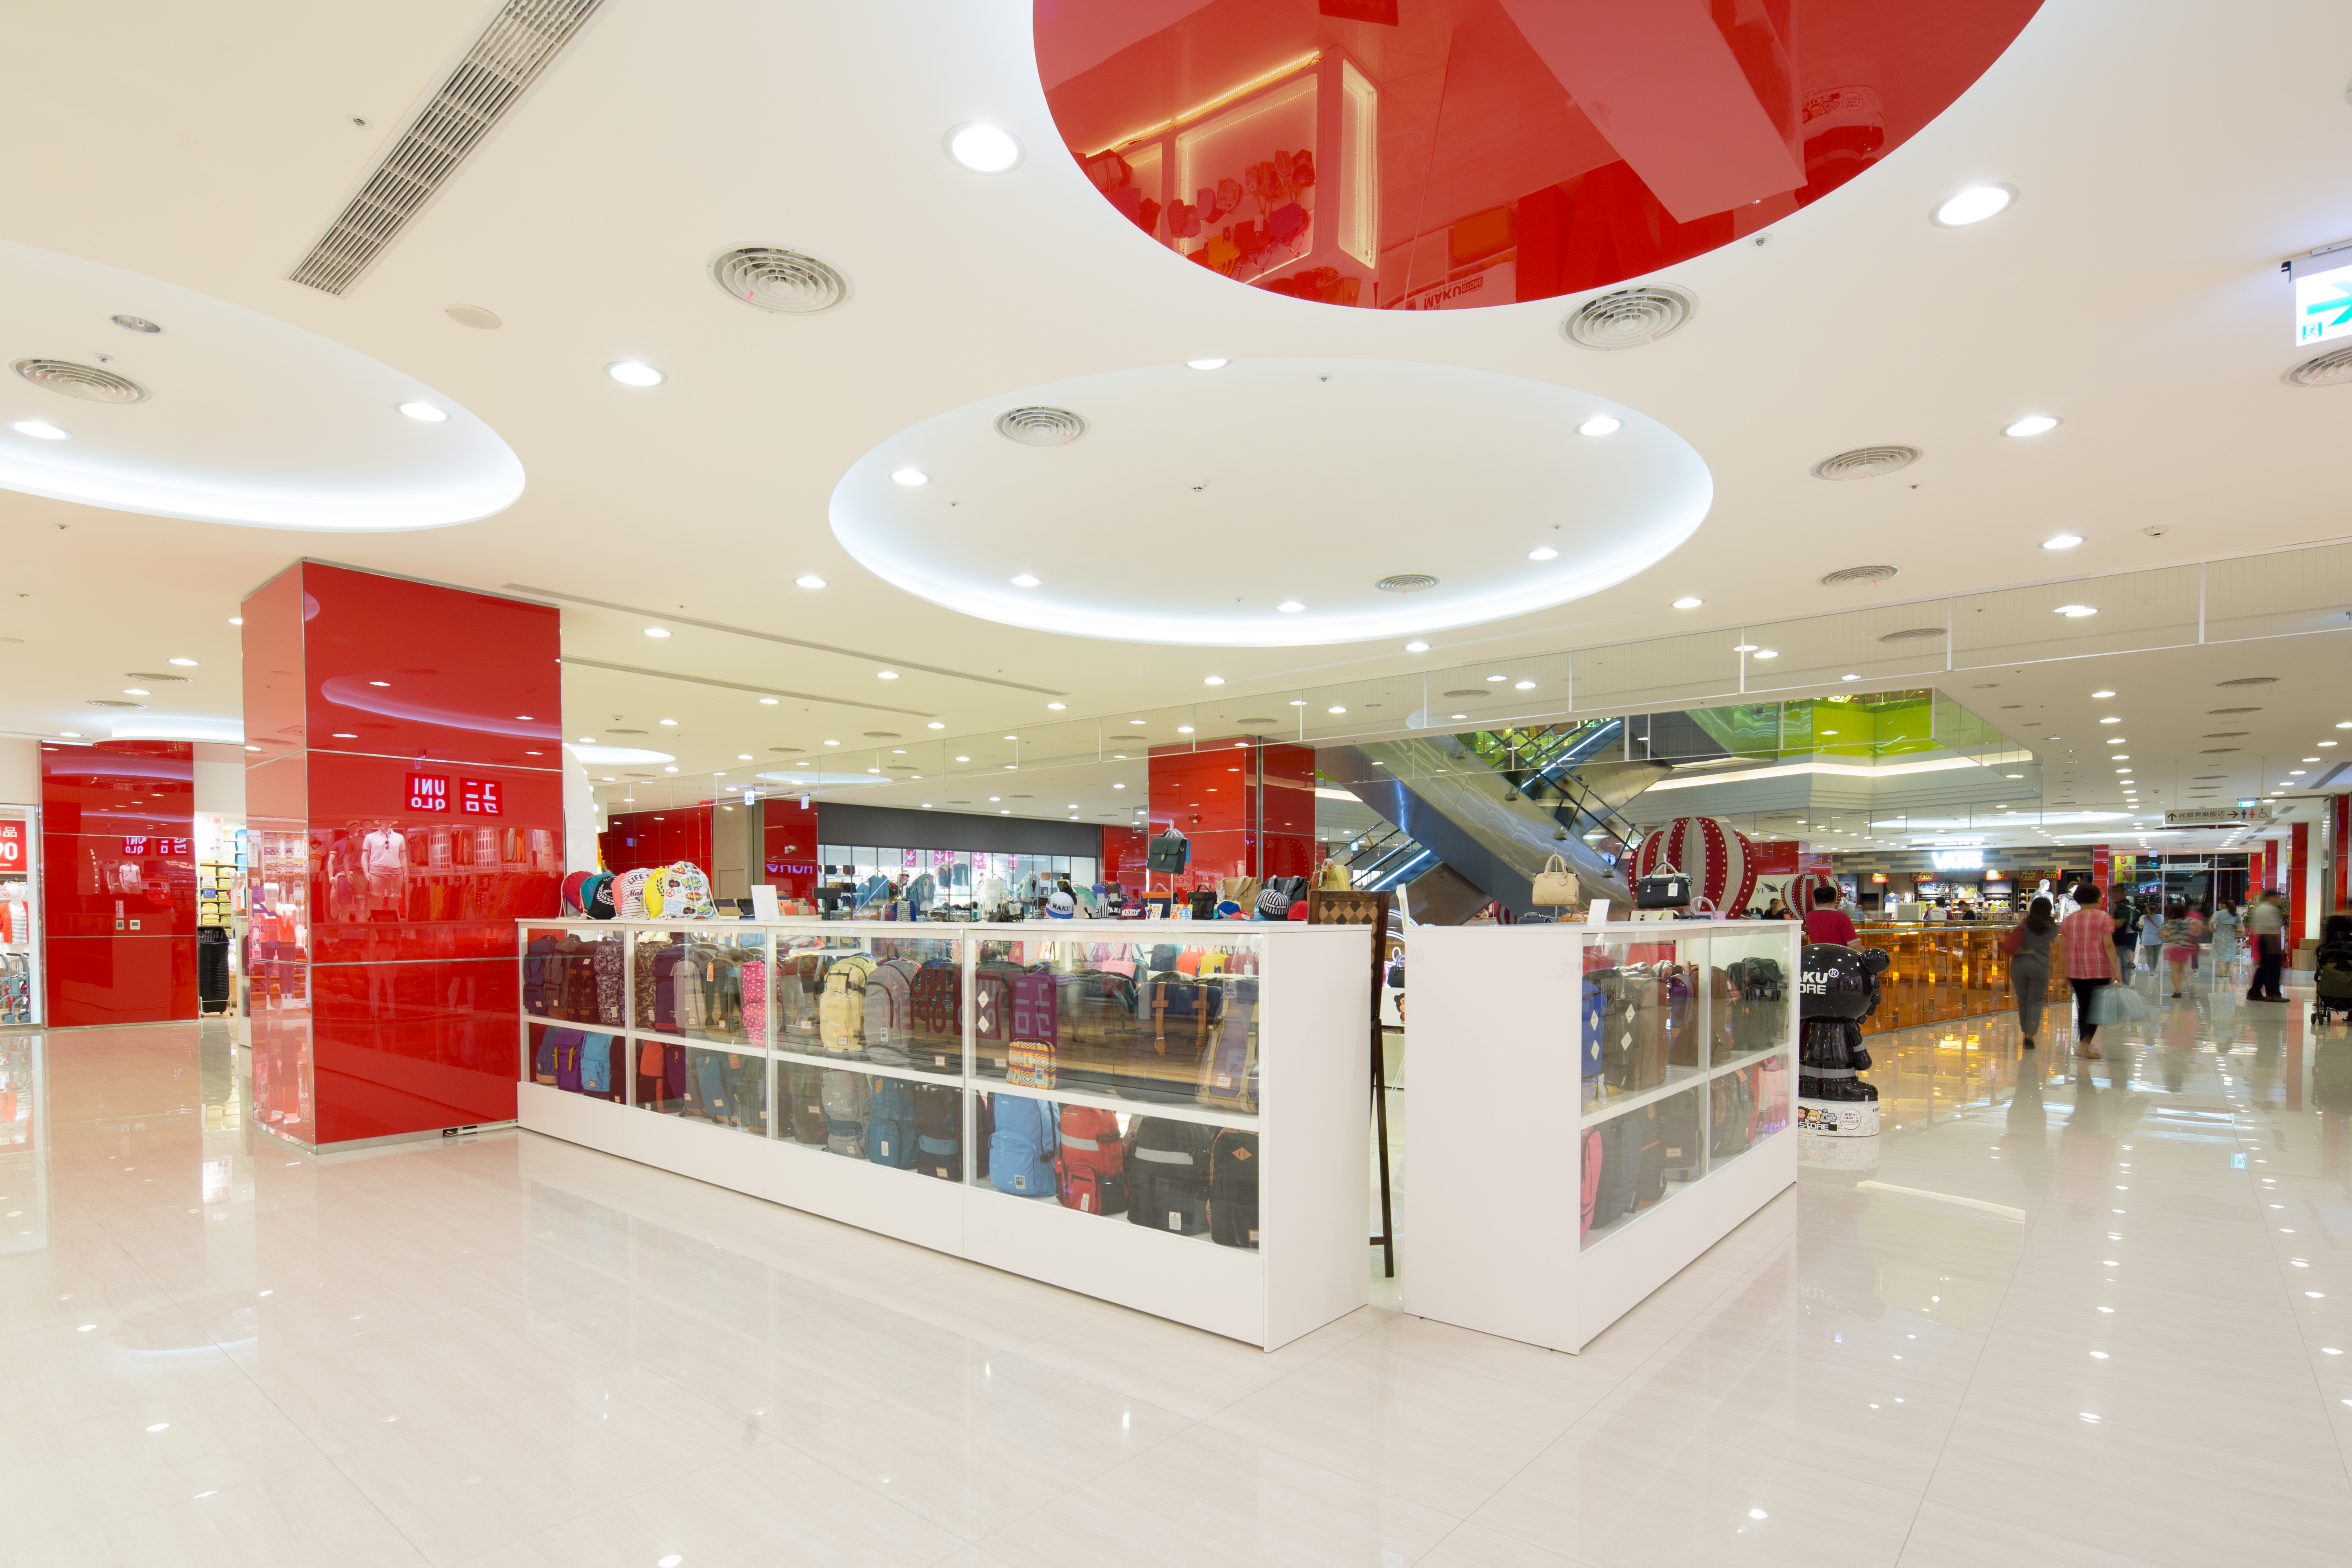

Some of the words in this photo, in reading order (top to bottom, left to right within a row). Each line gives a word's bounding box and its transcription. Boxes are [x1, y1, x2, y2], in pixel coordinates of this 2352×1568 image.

[0, 826, 17, 837] 品
[0, 842, 18, 860] 0
[1931, 851, 1983, 869] VANS
[628, 874, 644, 884] LIFE
[1052, 903, 1071, 911] MAKU
[1799, 1122, 1829, 1130] STORE
